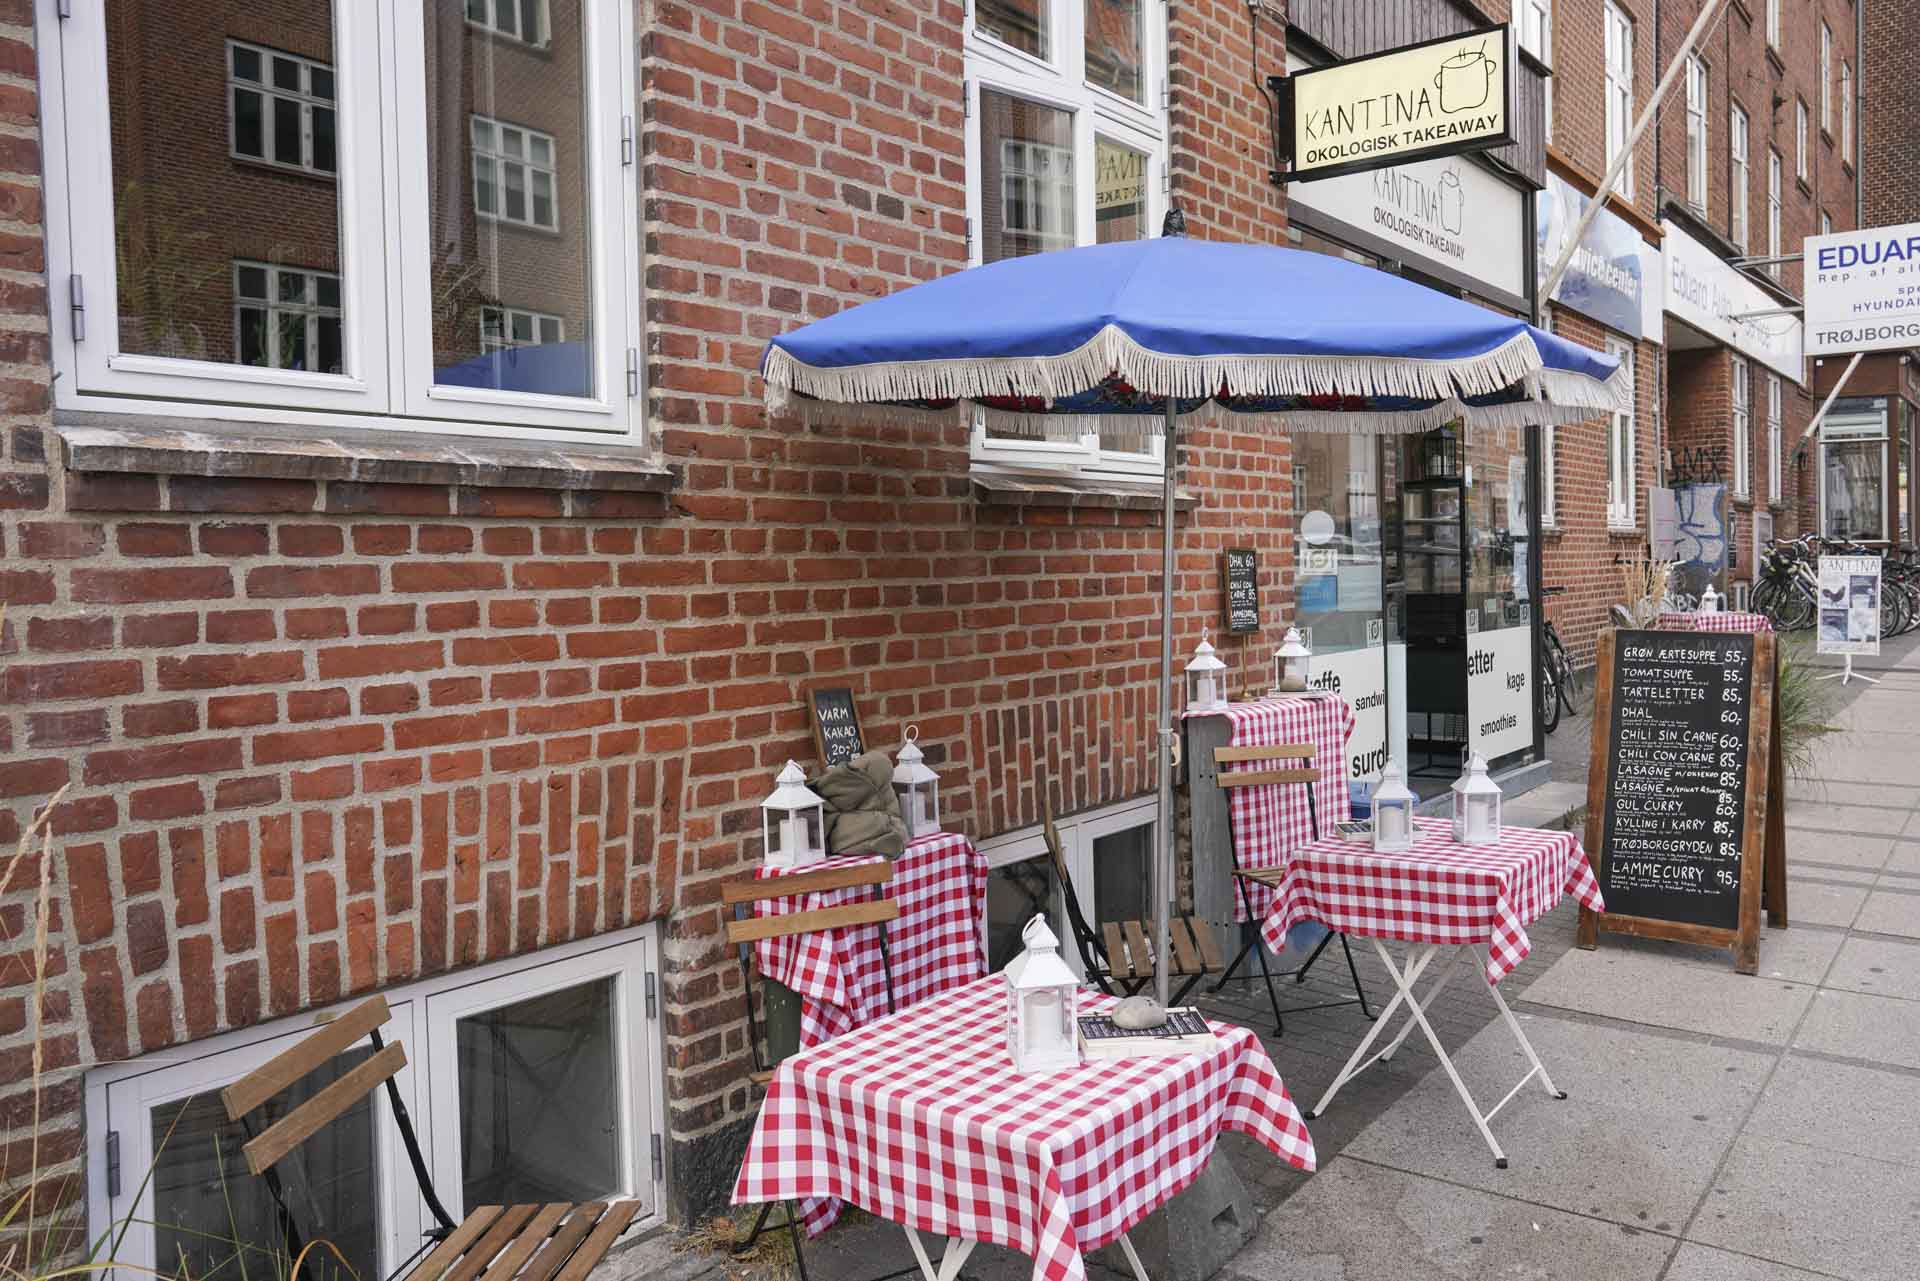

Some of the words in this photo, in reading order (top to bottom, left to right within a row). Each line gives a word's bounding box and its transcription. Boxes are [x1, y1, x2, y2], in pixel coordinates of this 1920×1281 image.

[1305, 87, 1433, 142] KANTINA
[1306, 132, 1398, 164] ØKOLOGISK
[1402, 113, 1498, 145] TAKEAWAY
[1373, 167, 1438, 226] KANTINA
[1373, 205, 1424, 244] ØKOLOGISK
[1425, 230, 1465, 261] TAKEAWAY
[1853, 298, 1920, 312] HYUNDAI
[1623, 647, 1654, 658] GRØN
[1506, 671, 1525, 693] kage
[1621, 686, 1705, 700] TARTELETTER
[817, 706, 849, 722] VARM
[1621, 707, 1653, 719] DHAL
[1480, 712, 1518, 737] smoothies
[823, 725, 856, 742] KAKAO
[1658, 730, 1678, 742] SIN
[1682, 730, 1719, 744] CARNE
[1652, 750, 1677, 761] CON
[1679, 751, 1716, 764] CARNE
[1617, 764, 1673, 778] LASAGNE
[1614, 780, 1665, 793] LASAGNE
[1616, 799, 1639, 811] GUL
[1643, 800, 1684, 812] CURRY
[1616, 817, 1658, 829] KYLLING
[1671, 819, 1706, 831] KARRY
